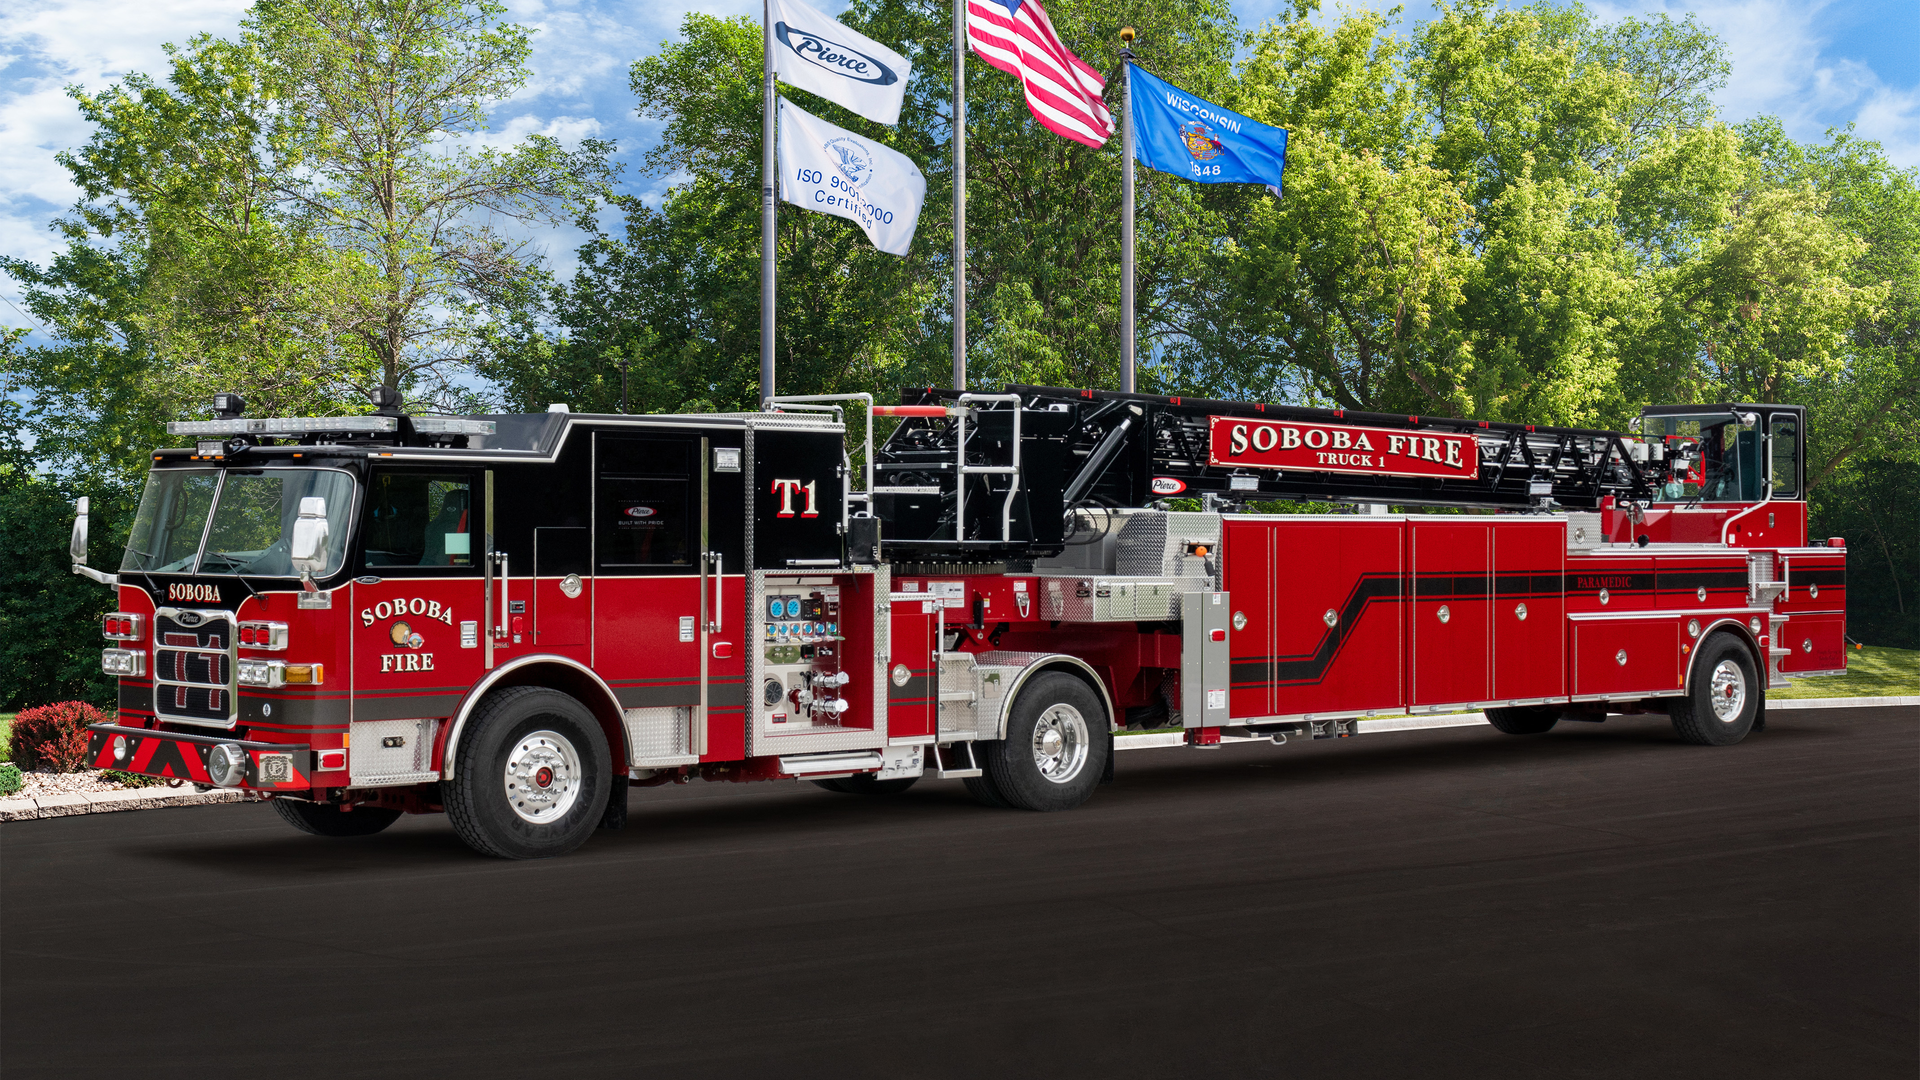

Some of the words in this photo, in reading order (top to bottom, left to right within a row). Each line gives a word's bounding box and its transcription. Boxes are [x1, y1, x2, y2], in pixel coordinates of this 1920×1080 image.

[796, 37, 868, 73] Pierce
[1166, 92, 1241, 134] WISCONSIN
[797, 168, 822, 184] ISO
[1190, 161, 1221, 176] 1848
[815, 190, 872, 229] Certified
[1230, 424, 1375, 457] SOBOBA
[1387, 434, 1463, 469] FIRE
[1316, 452, 1373, 467] TRUCK
[1378, 456, 1385, 468] 1
[1153, 480, 1176, 490] Pierce
[771, 479, 819, 518] T1
[1577, 576, 1632, 588] PARAMEDIC
[168, 583, 221, 603] SOBOBA
[181, 613, 199, 624] Pierce
[361, 598, 452, 628] SOBOBA
[380, 653, 434, 673] FIRE
